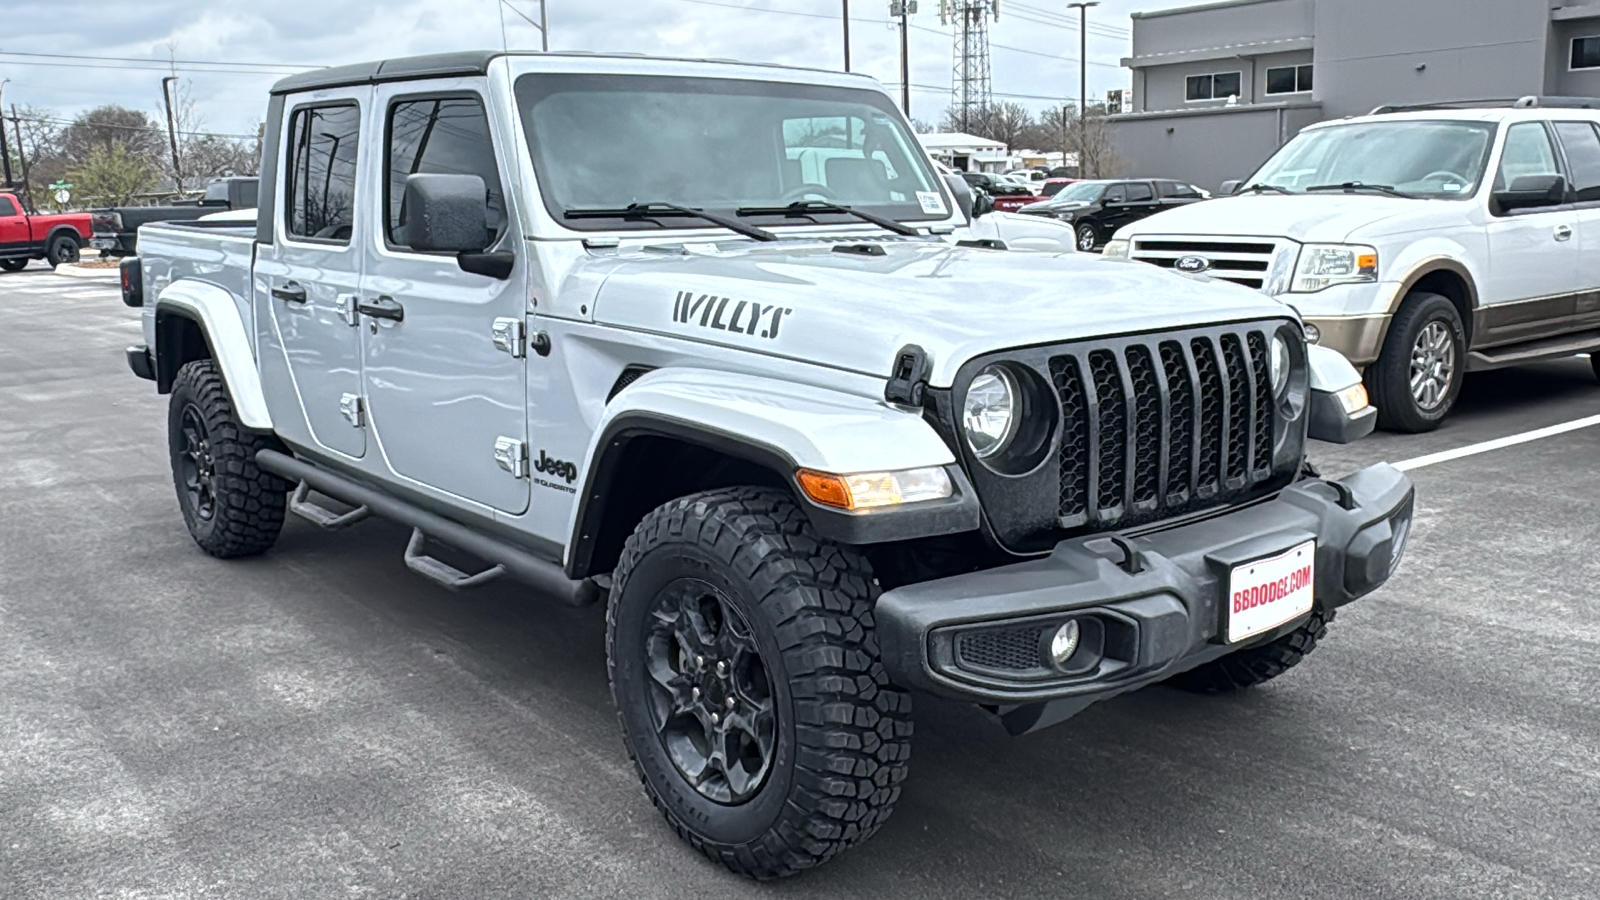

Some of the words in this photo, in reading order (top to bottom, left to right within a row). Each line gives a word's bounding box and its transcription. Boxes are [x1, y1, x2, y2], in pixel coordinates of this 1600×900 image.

[1180, 258, 1200, 268] Ford
[673, 290, 793, 339] WILLYS
[534, 449, 577, 484] Jeep
[1233, 565, 1311, 614] BBDODGE.COM
